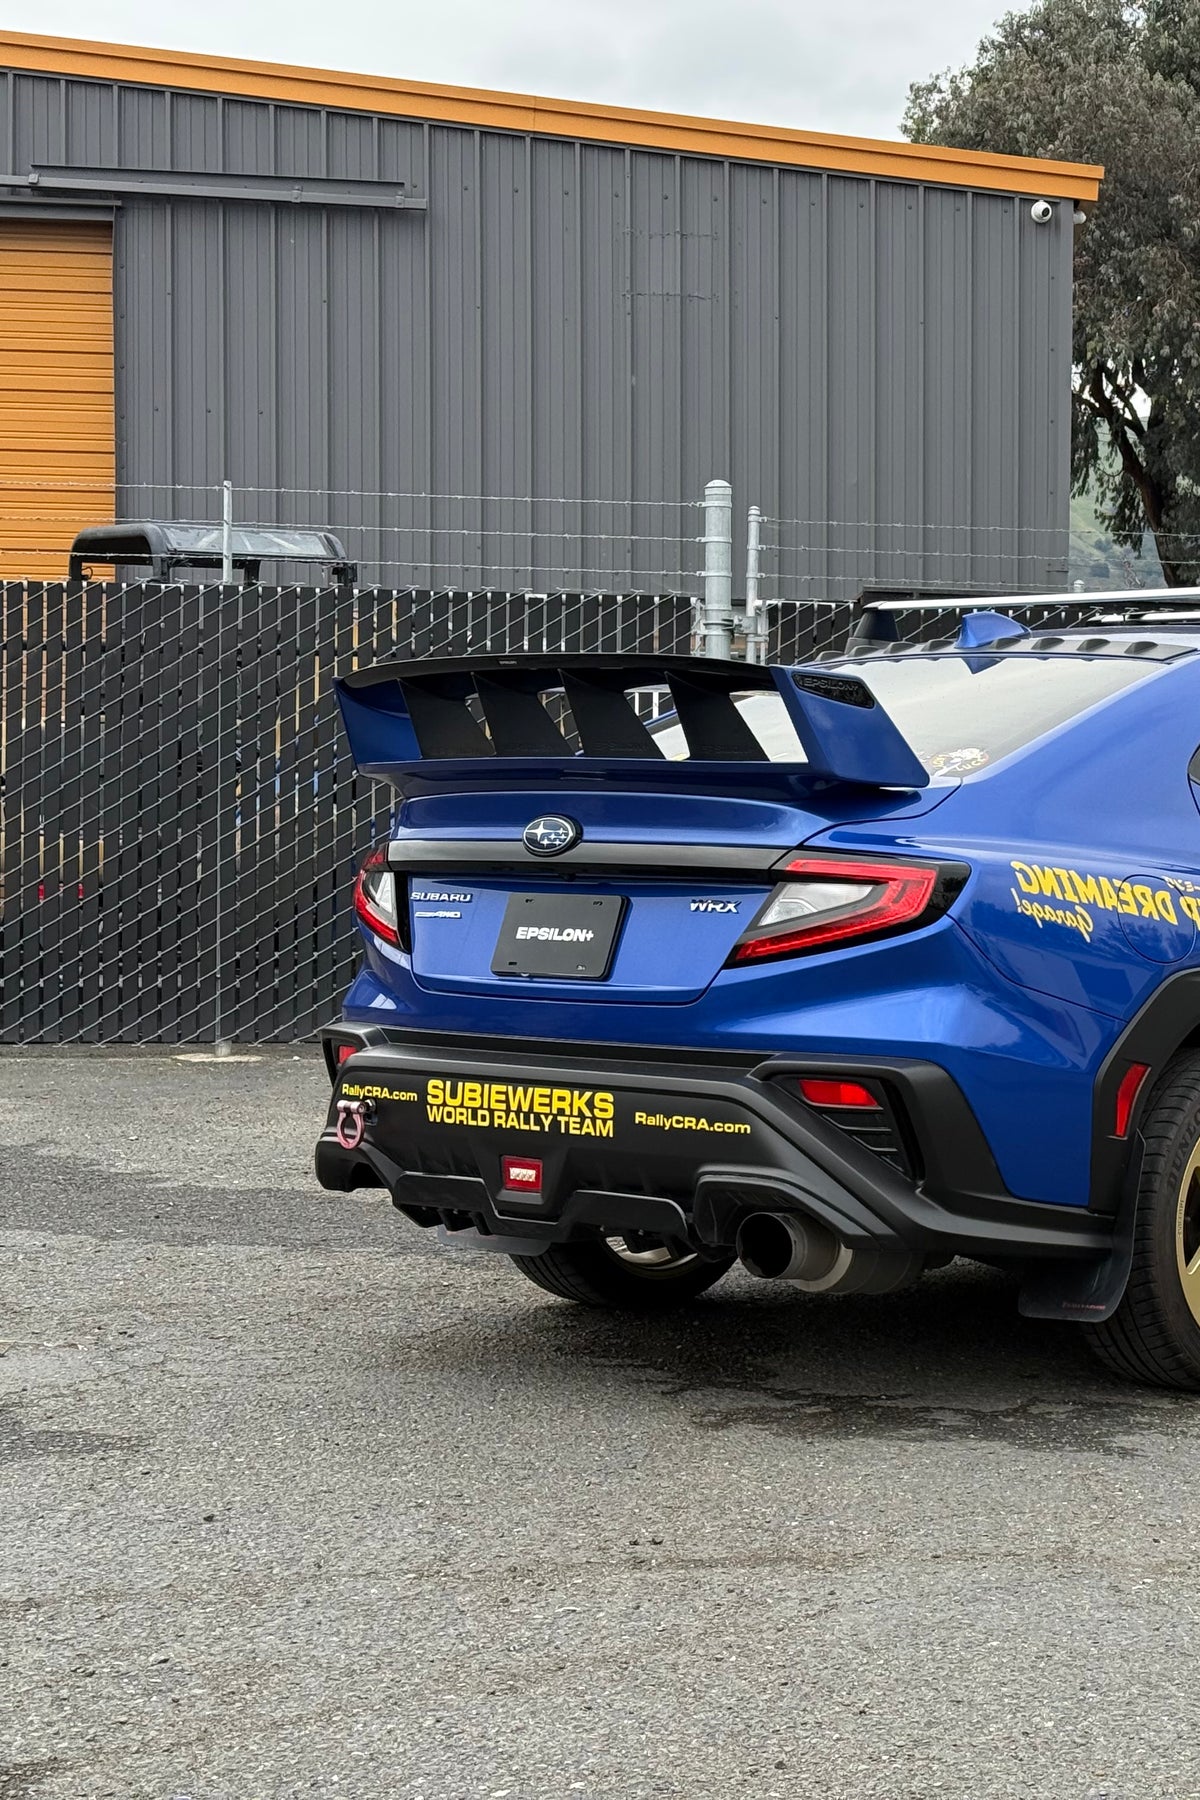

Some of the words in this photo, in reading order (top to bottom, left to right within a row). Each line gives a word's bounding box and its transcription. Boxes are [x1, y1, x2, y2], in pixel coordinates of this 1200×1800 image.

[410, 891, 472, 903] SUBARU
[689, 899, 741, 914] WRX
[515, 926, 595, 942] EPSILON+
[341, 1083, 418, 1101] RallyCRA.com
[426, 1079, 615, 1120] SUBIEWERKS
[426, 1105, 490, 1127] WORLD
[493, 1110, 554, 1132] RALLY
[557, 1116, 614, 1138] TEAM
[634, 1111, 751, 1135] RallyCRA.com
